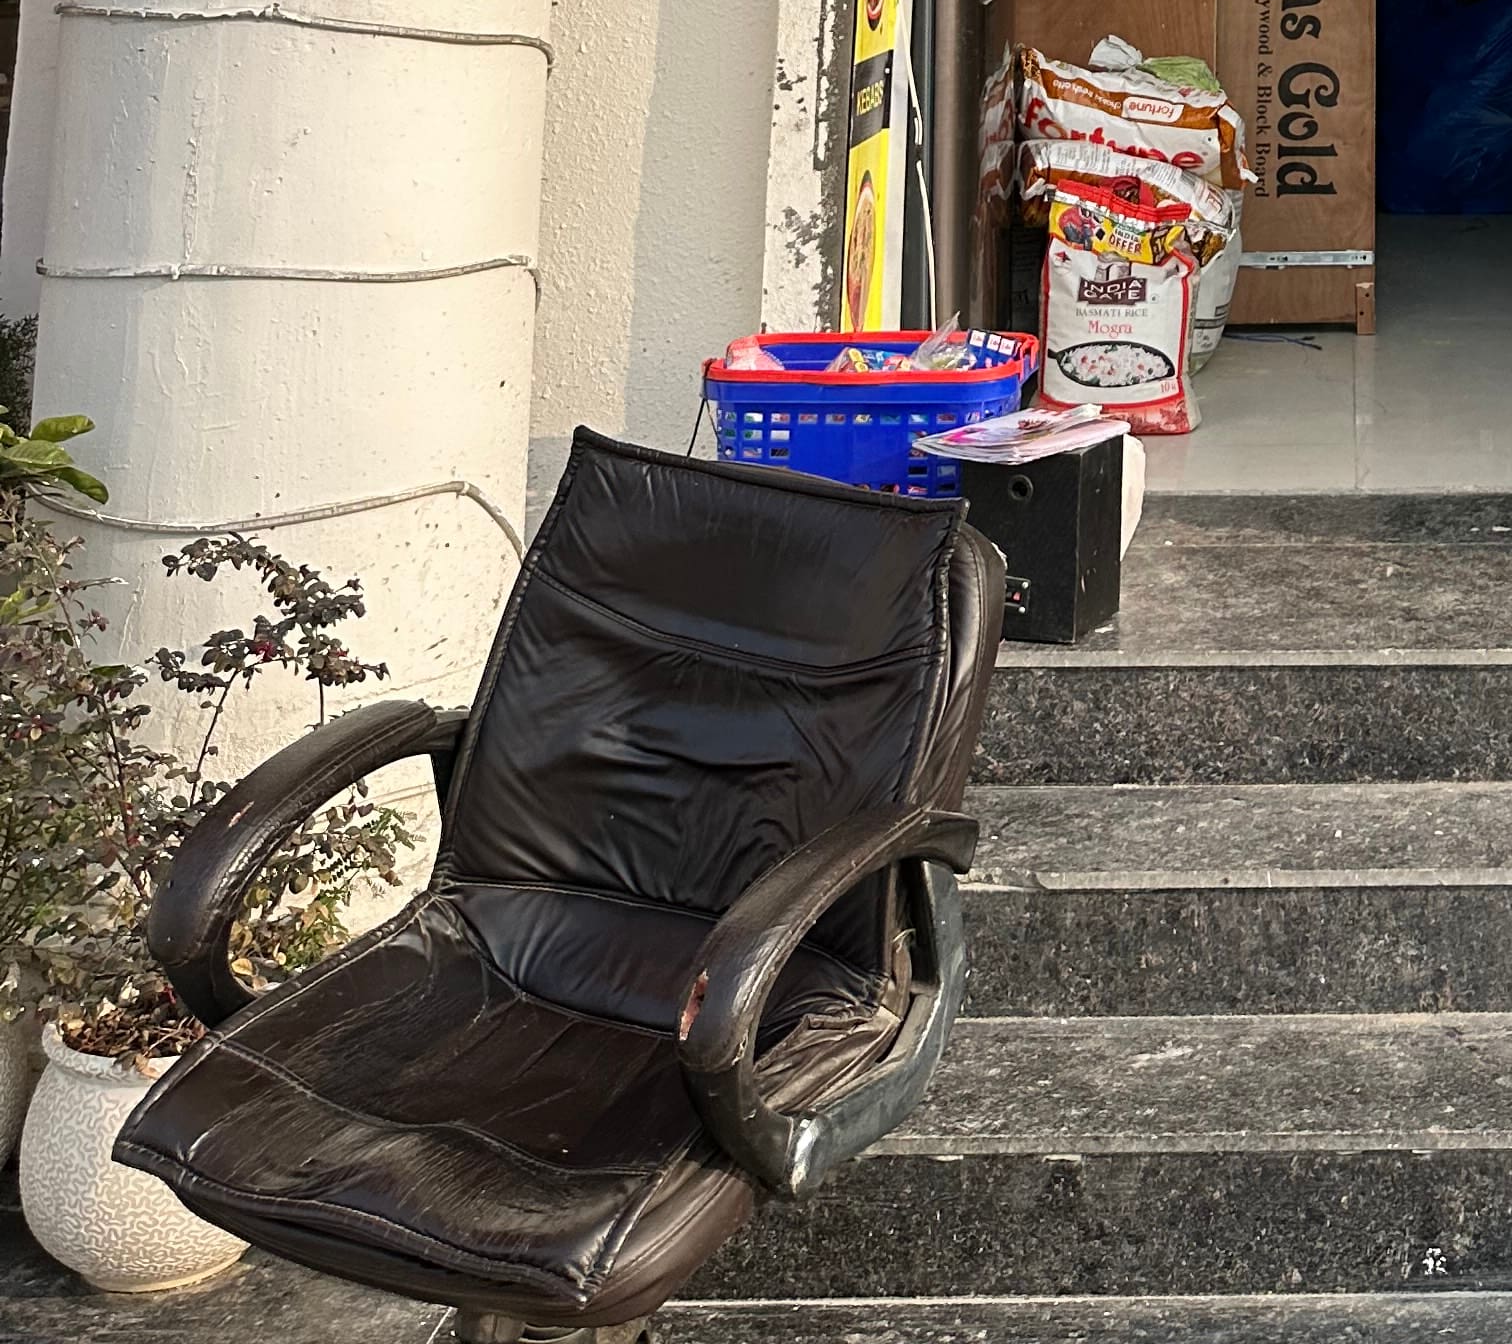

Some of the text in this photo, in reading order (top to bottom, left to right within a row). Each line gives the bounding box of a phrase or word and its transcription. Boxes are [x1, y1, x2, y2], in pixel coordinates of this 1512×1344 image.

[1257, 61, 1273, 79] &
[1127, 100, 1176, 119] fortune
[1254, 84, 1273, 137] Block
[1275, 61, 1342, 198] Gold
[1253, 141, 1272, 199] Board
[1108, 233, 1143, 255] OFFER
[1083, 278, 1144, 293] INDIA
[1083, 289, 1140, 301] GATE
[1075, 307, 1148, 318] BASMATI RICE
[1087, 319, 1133, 338] Mogra
